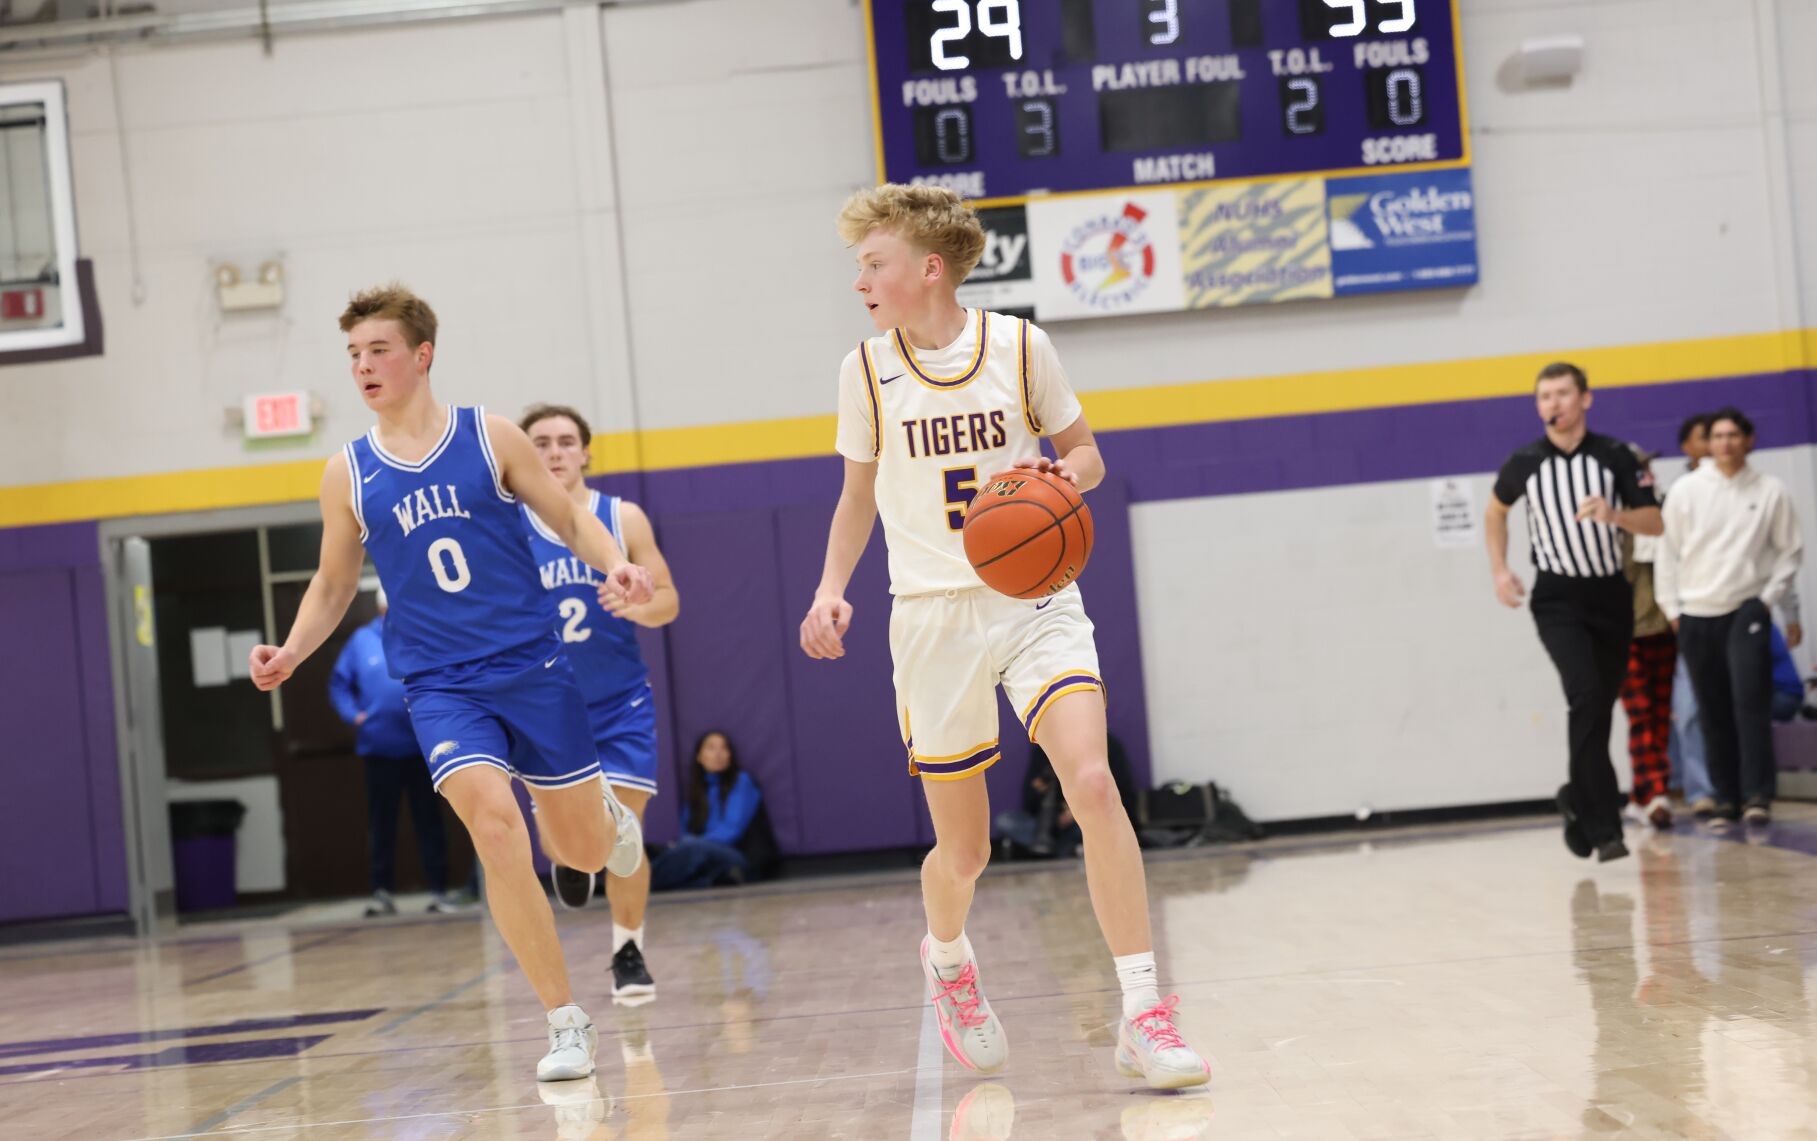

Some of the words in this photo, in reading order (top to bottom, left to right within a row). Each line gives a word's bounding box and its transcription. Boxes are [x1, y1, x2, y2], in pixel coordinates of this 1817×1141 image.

[930, 0, 1023, 70] 29
[1149, 0, 1179, 44] 3
[1092, 59, 1180, 91] PLAYER
[1185, 54, 1246, 83] FOUL
[1267, 47, 1333, 76] T.O.L.
[1353, 37, 1429, 68] FOULS
[902, 76, 977, 106] FOULS
[1002, 70, 1067, 98] T.O.L.
[1287, 79, 1318, 133] 2
[1386, 70, 1421, 125] 0
[935, 108, 968, 162] 0
[1023, 101, 1053, 155] 3
[1361, 133, 1438, 164] SCORE
[1133, 152, 1215, 183] MATCH
[1370, 186, 1472, 216] Golden
[1374, 212, 1444, 236] West
[902, 410, 1007, 458] TIGERS
[392, 484, 471, 537] WALL
[941, 465, 979, 533] 5
[427, 537, 471, 593] 0
[539, 556, 601, 590] WALL
[558, 597, 592, 643] 2
